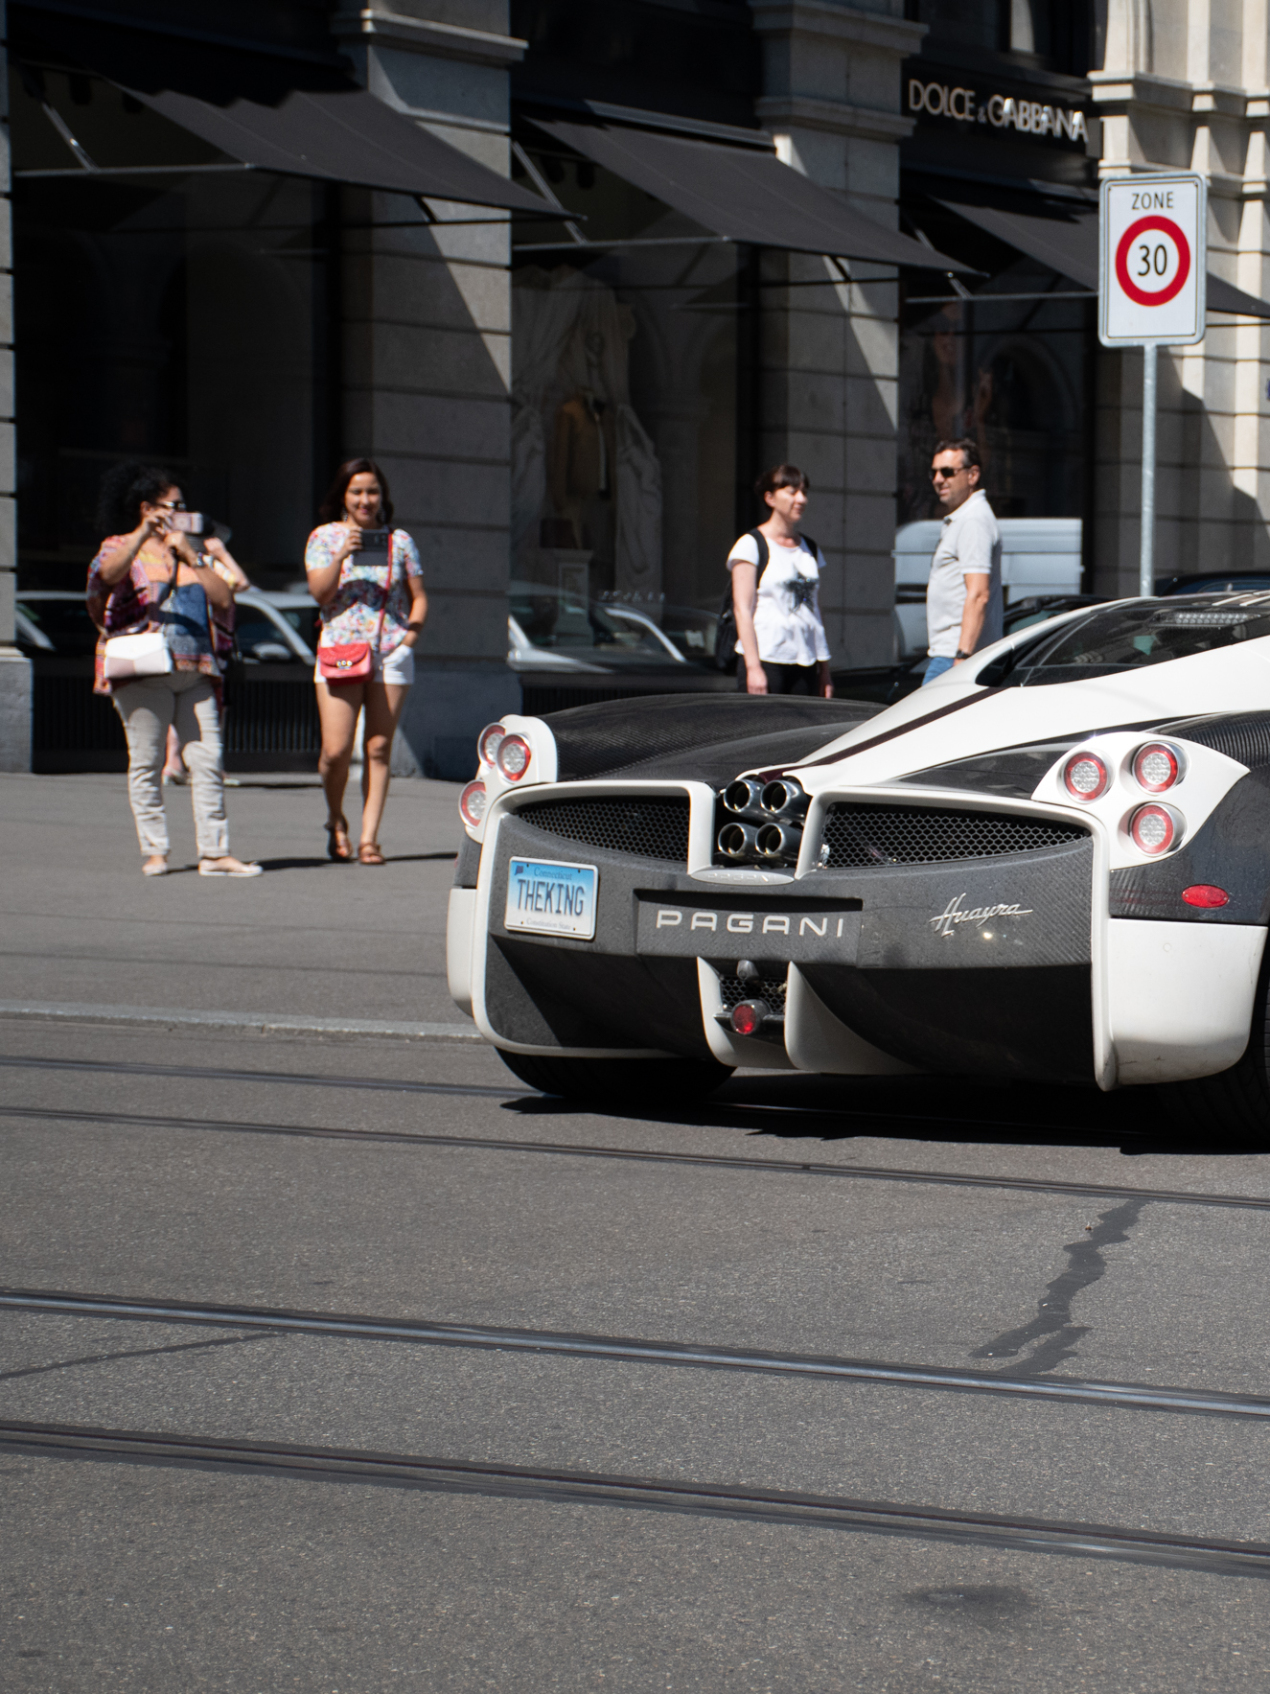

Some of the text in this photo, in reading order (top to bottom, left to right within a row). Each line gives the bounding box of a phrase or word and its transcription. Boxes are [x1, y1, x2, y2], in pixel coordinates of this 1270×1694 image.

[909, 79, 1089, 143] DOLCE & GABBANA
[1131, 191, 1174, 210] ZONE
[1137, 243, 1168, 277] 30
[534, 867, 573, 881] Connecticut
[518, 879, 585, 916] THEKING
[929, 892, 1033, 937] Huayra
[656, 909, 844, 938] PAGANI
